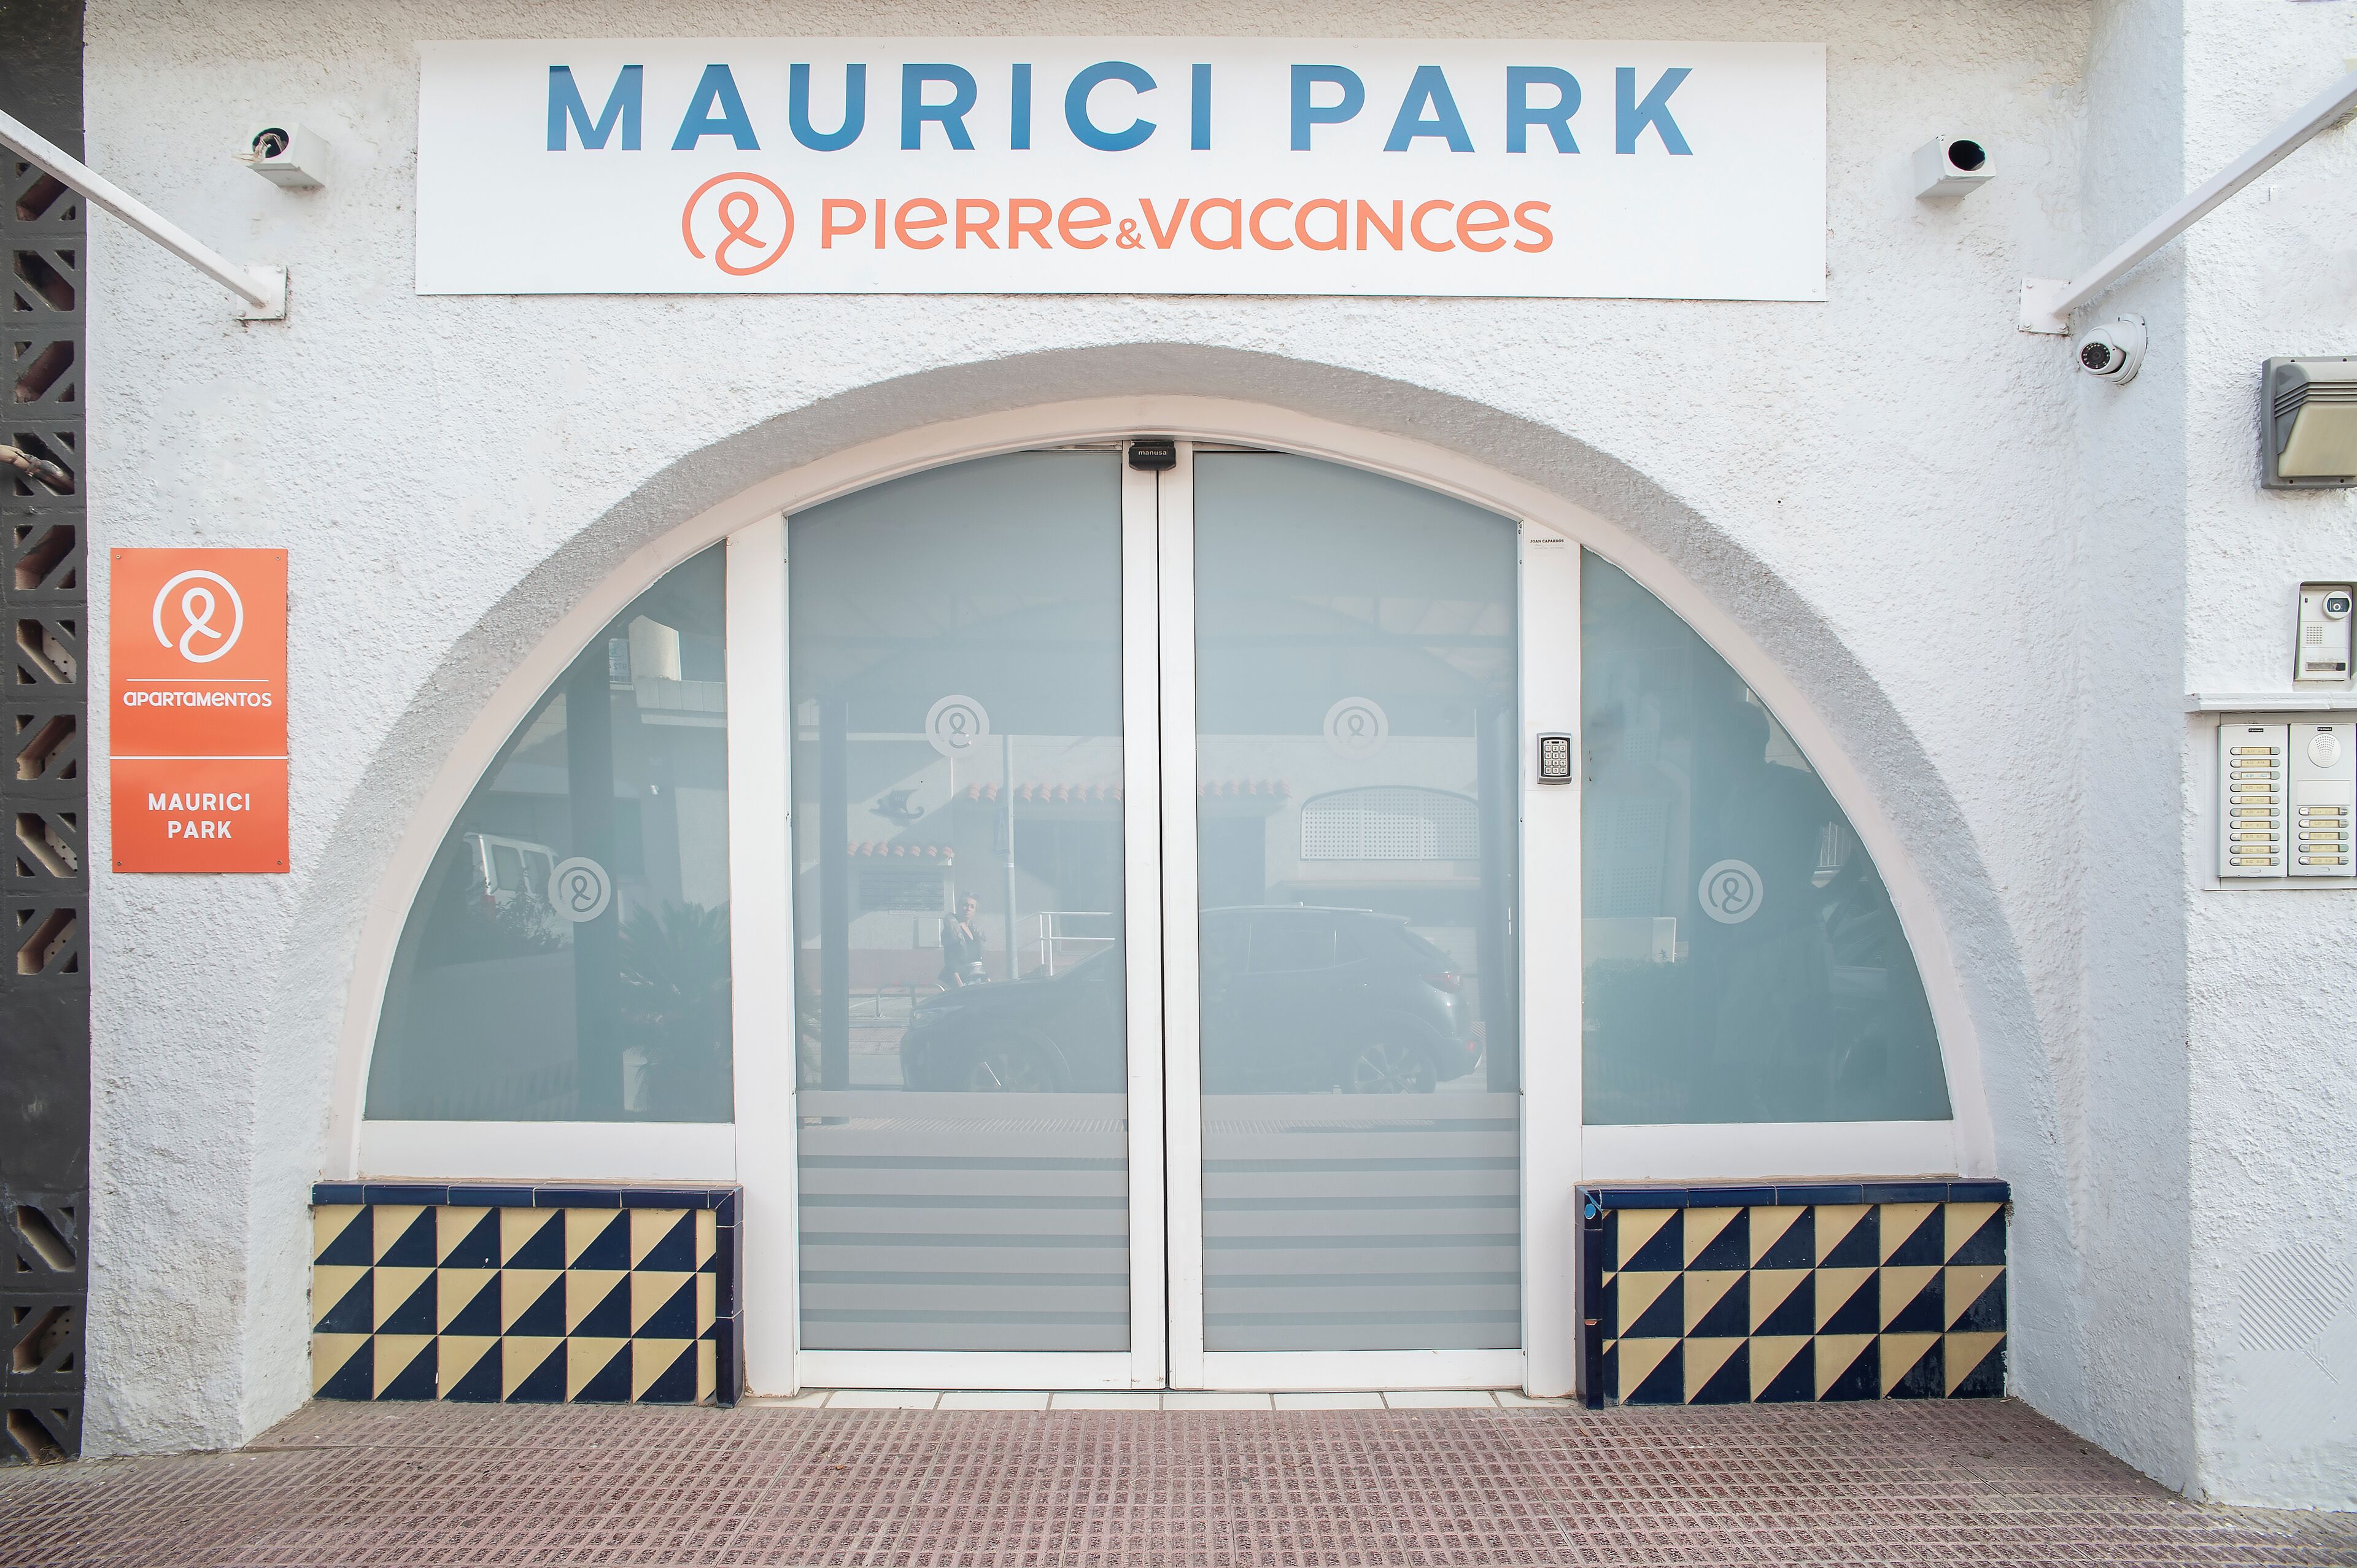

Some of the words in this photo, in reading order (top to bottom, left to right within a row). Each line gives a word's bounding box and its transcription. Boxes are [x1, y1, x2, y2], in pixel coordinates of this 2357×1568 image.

[546, 60, 1211, 152] MAURICI
[1290, 63, 1692, 155] PARK
[148, 793, 250, 811] MAURICI
[168, 821, 232, 839] PARK
